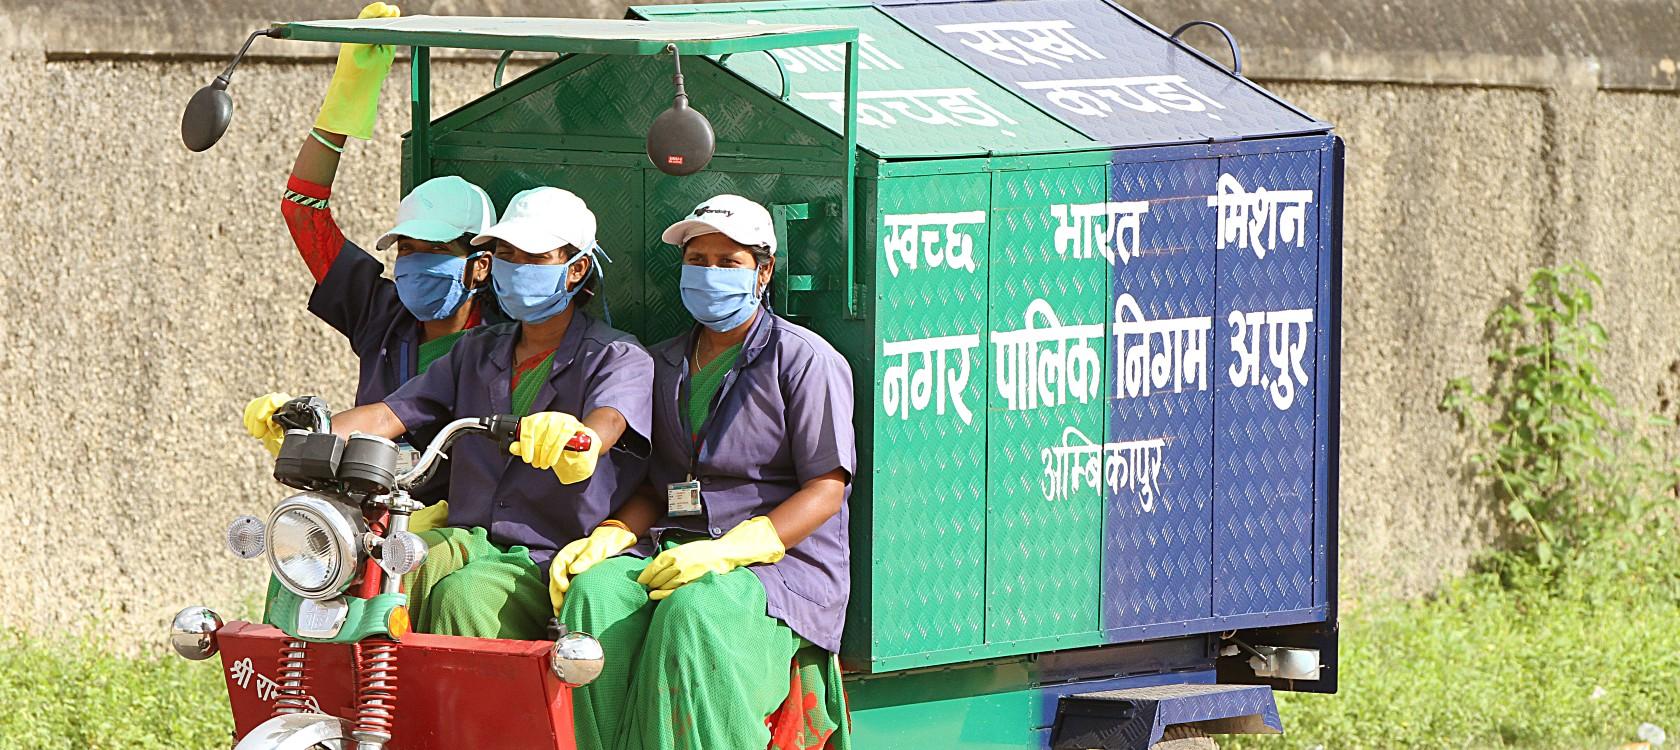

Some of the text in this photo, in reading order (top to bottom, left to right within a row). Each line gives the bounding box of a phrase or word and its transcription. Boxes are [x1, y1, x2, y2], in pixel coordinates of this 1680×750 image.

[934, 20, 1107, 70] सूखा
[883, 172, 1313, 278] स्वच्छ भारत मिशन
[882, 333, 980, 425] नगर
[1112, 292, 1212, 400] निगम
[1040, 426, 1166, 512] अम्बिकापुर
[229, 657, 255, 689] श्री
